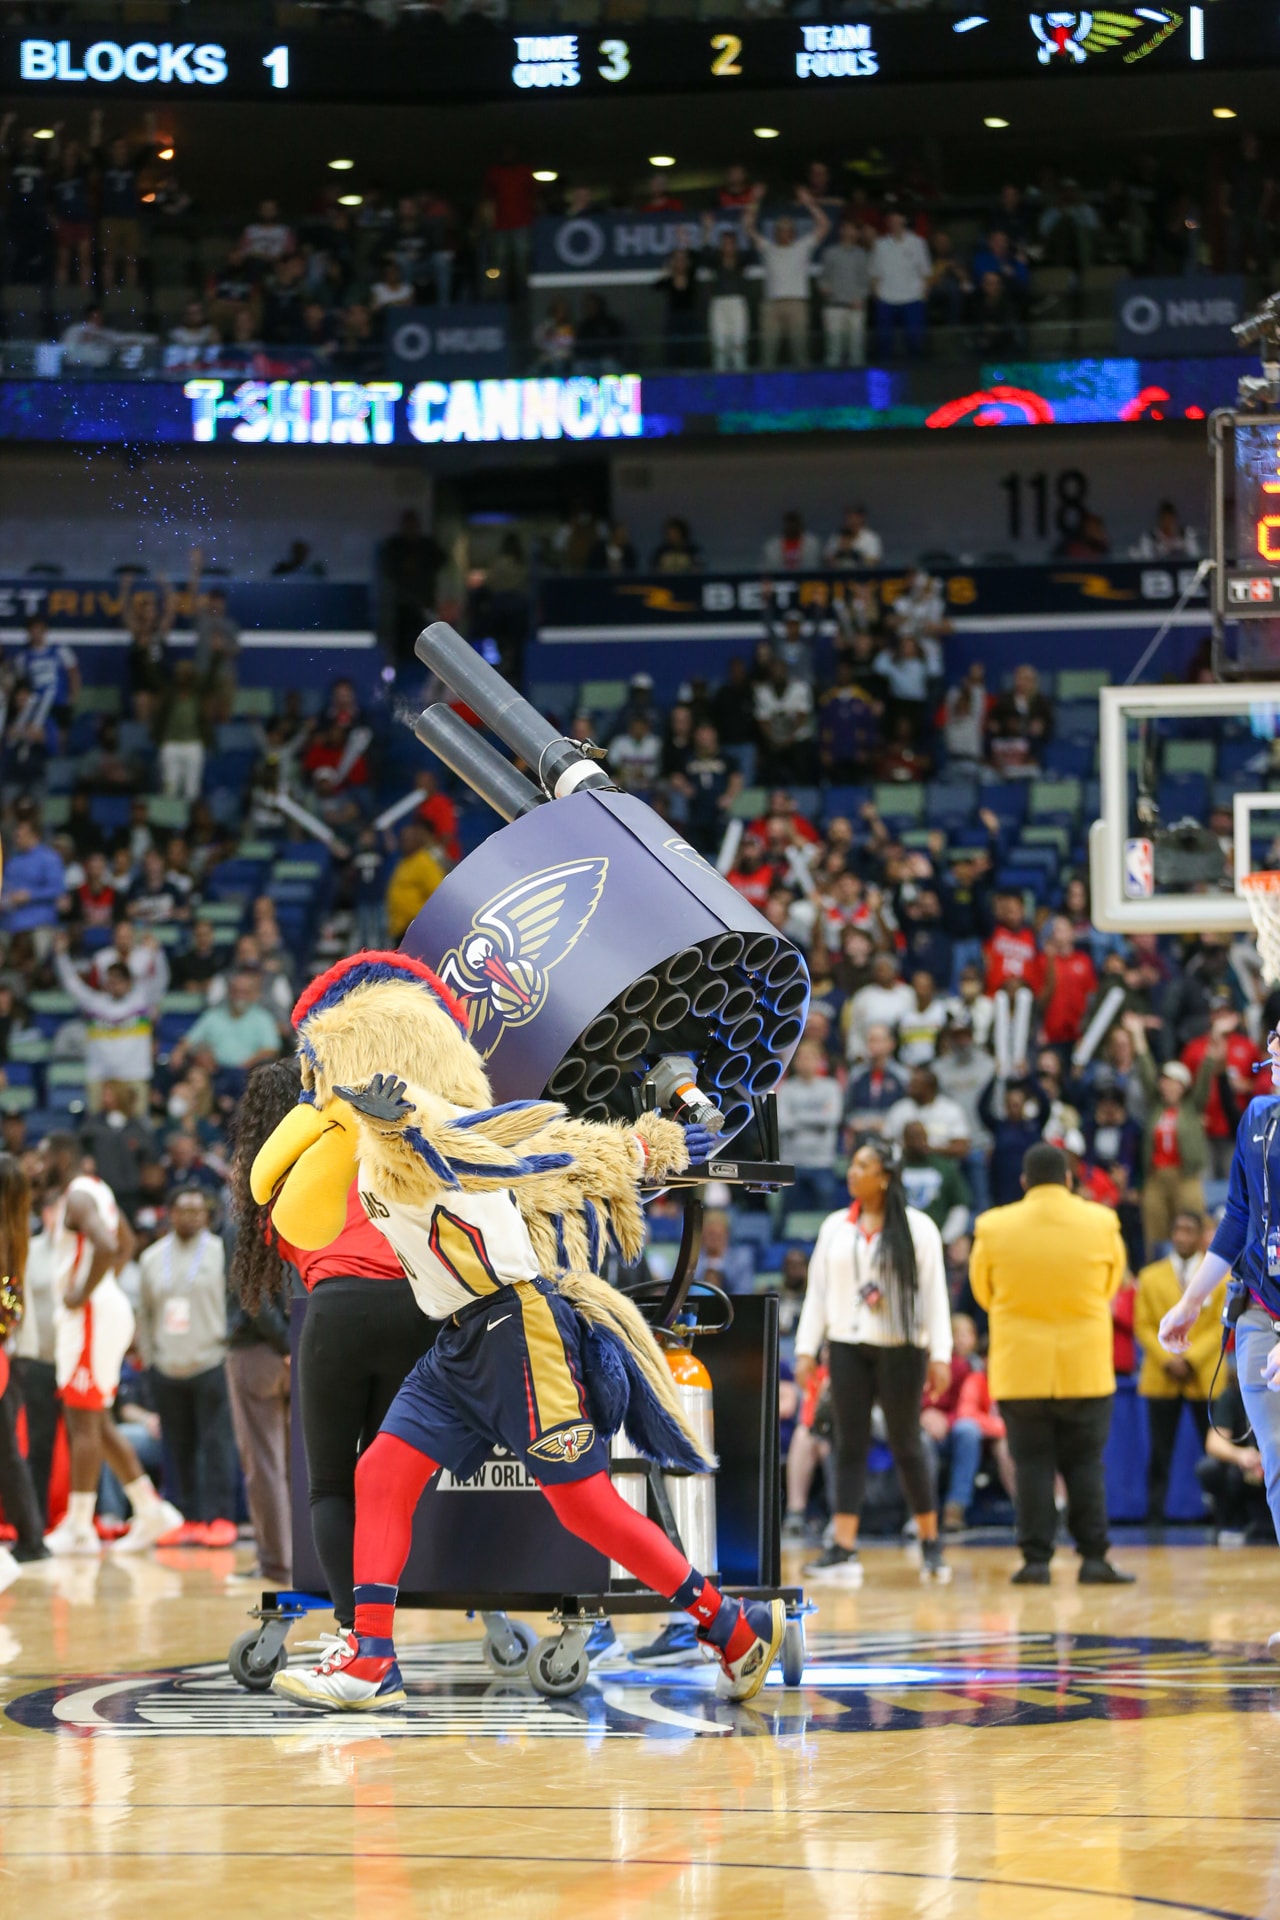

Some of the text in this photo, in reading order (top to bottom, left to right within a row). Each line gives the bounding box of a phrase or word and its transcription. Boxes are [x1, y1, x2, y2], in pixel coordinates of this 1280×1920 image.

[710, 34, 742, 75] 2
[800, 23, 871, 51] TEAM
[20, 39, 289, 88] BLOCKS 1
[598, 39, 631, 82] 3
[795, 49, 880, 78] FOULS
[184, 374, 642, 444] T-SHIRT CANNON
[1002, 469, 1088, 540] 118
[491, 1464, 539, 1487] ORLE
